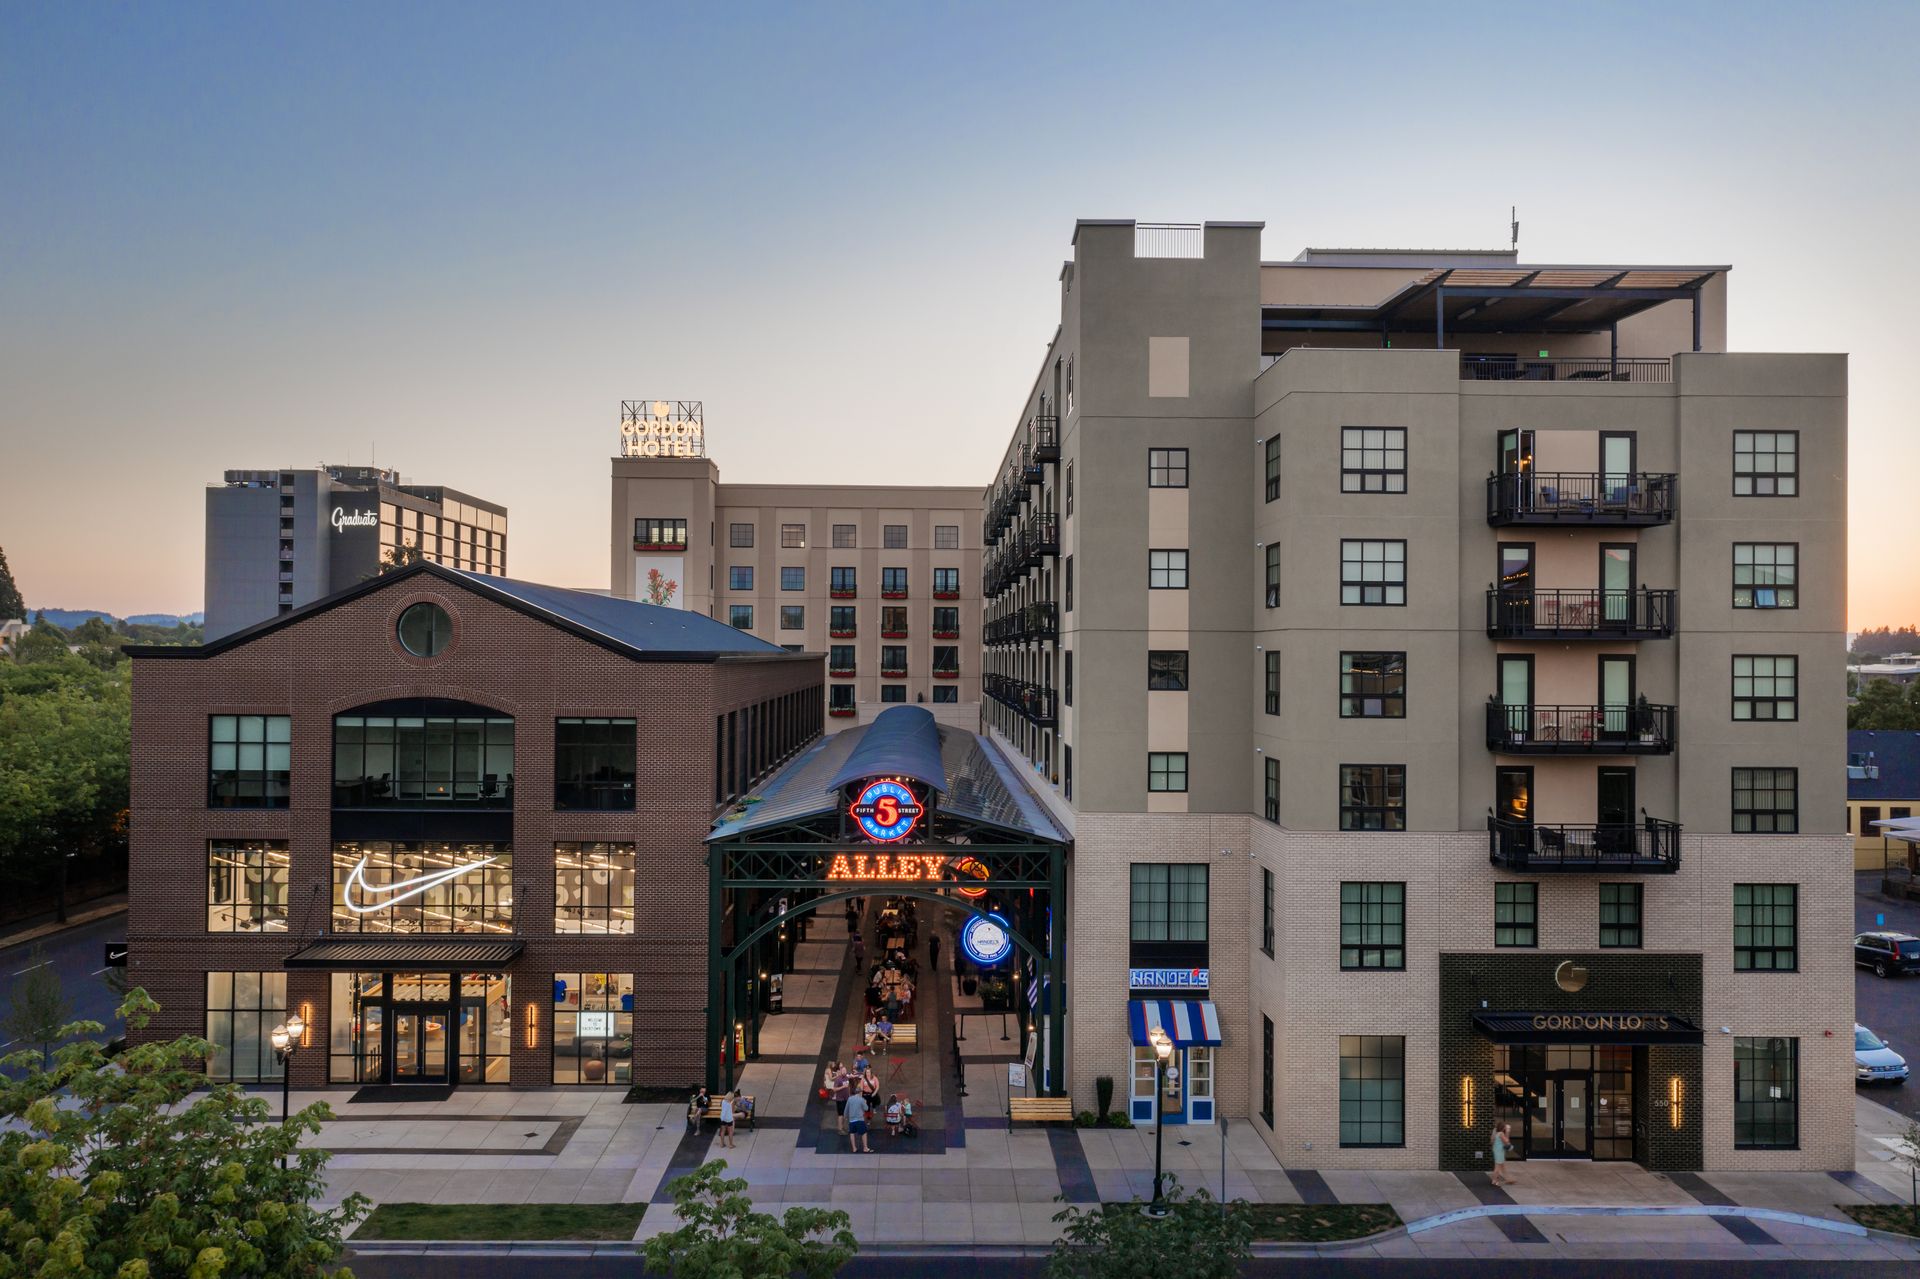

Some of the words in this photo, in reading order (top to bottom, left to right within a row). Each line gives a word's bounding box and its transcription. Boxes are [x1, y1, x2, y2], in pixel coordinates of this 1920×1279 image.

[621, 420, 701, 437] GORDON
[627, 440, 695, 457] HOTEL
[331, 506, 378, 533] Graduate
[866, 784, 909, 800] PUBLIC
[876, 798, 897, 826] 5
[865, 820, 909, 837] MARKET
[827, 854, 946, 880] ALLEY
[1533, 1015, 1613, 1030] GORDON
